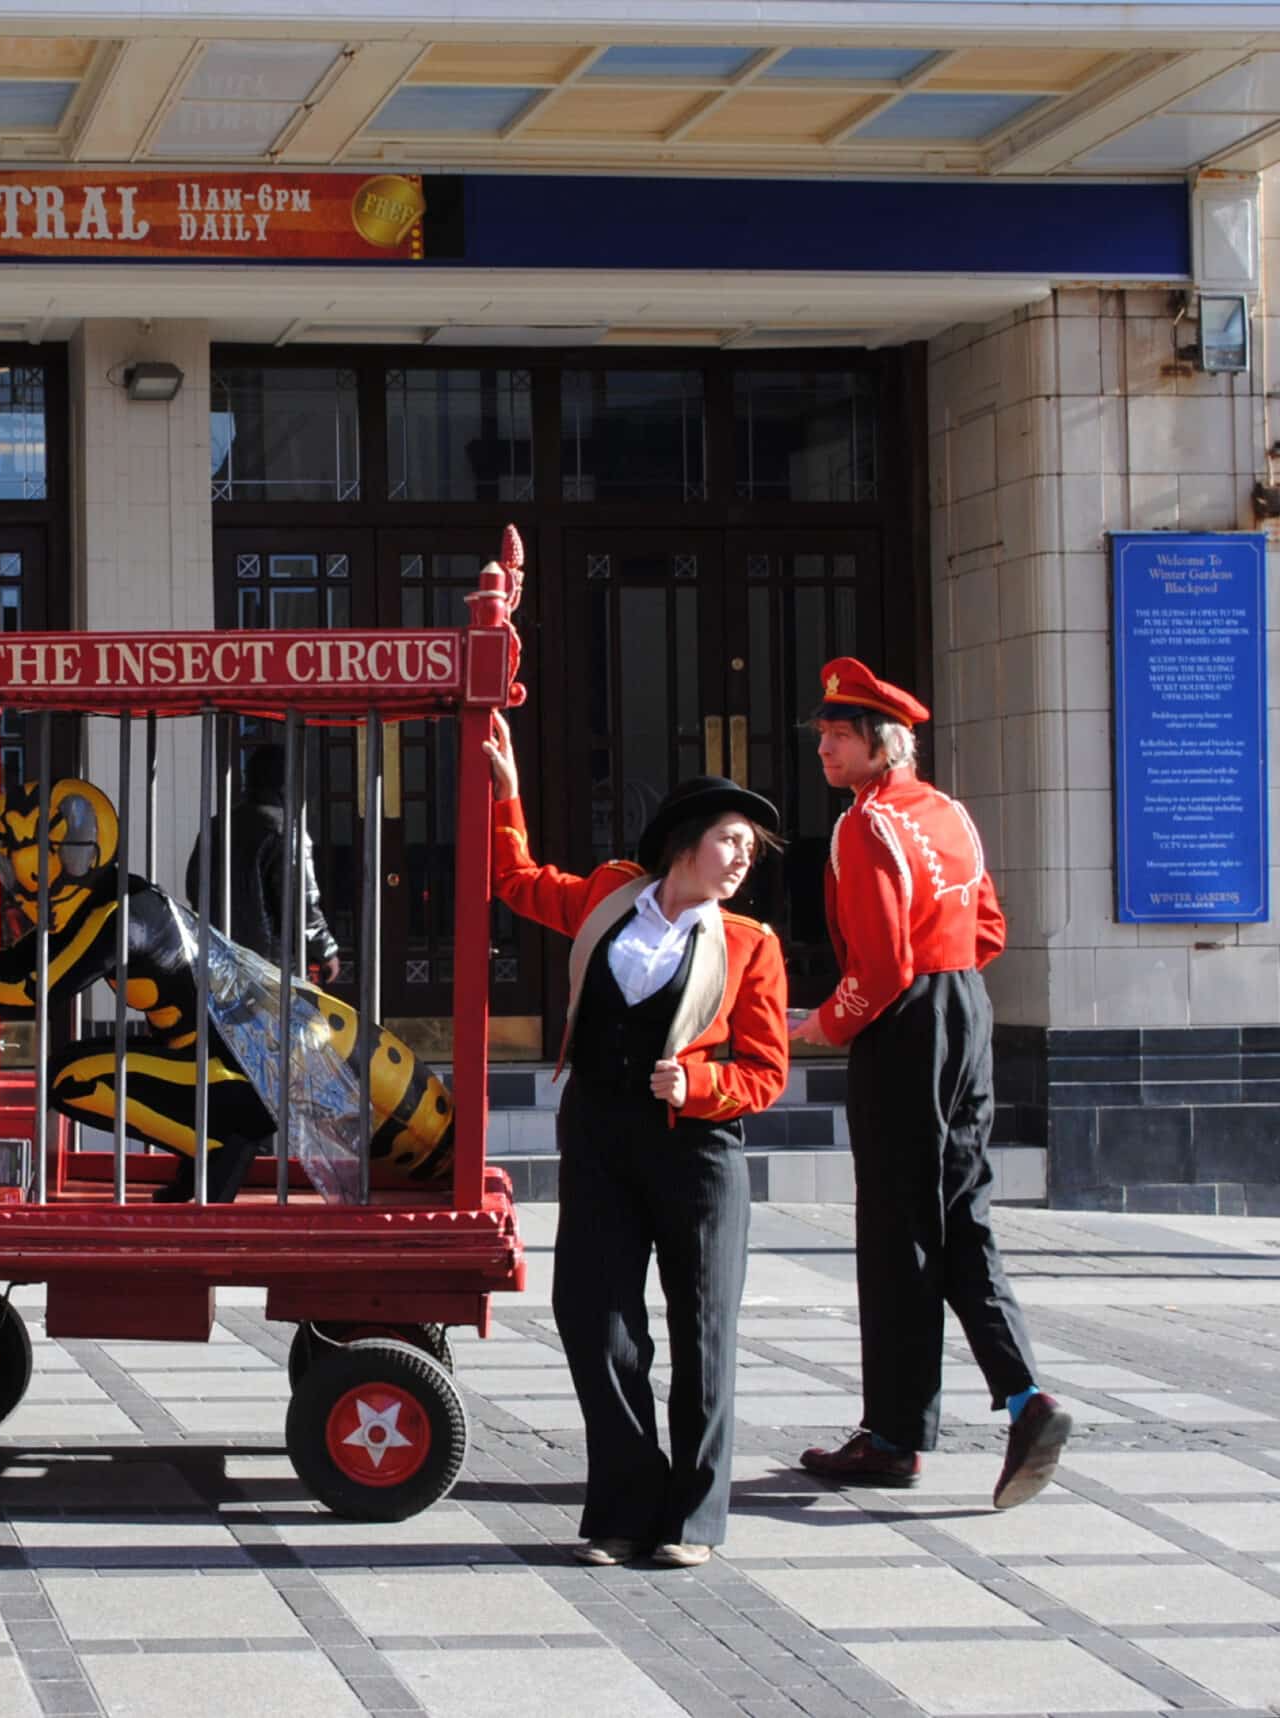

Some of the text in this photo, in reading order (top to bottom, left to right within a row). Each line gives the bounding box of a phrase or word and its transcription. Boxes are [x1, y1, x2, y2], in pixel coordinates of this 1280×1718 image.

[177, 182, 312, 213] 11AM-6PM
[178, 212, 271, 242] DAILY
[1156, 553, 1222, 566] Welcome To
[1148, 567, 1233, 581] Winter Gardens
[1164, 582, 1218, 597] Blackpool
[94, 640, 275, 685] INSECT
[285, 639, 453, 684] CIRCUS
